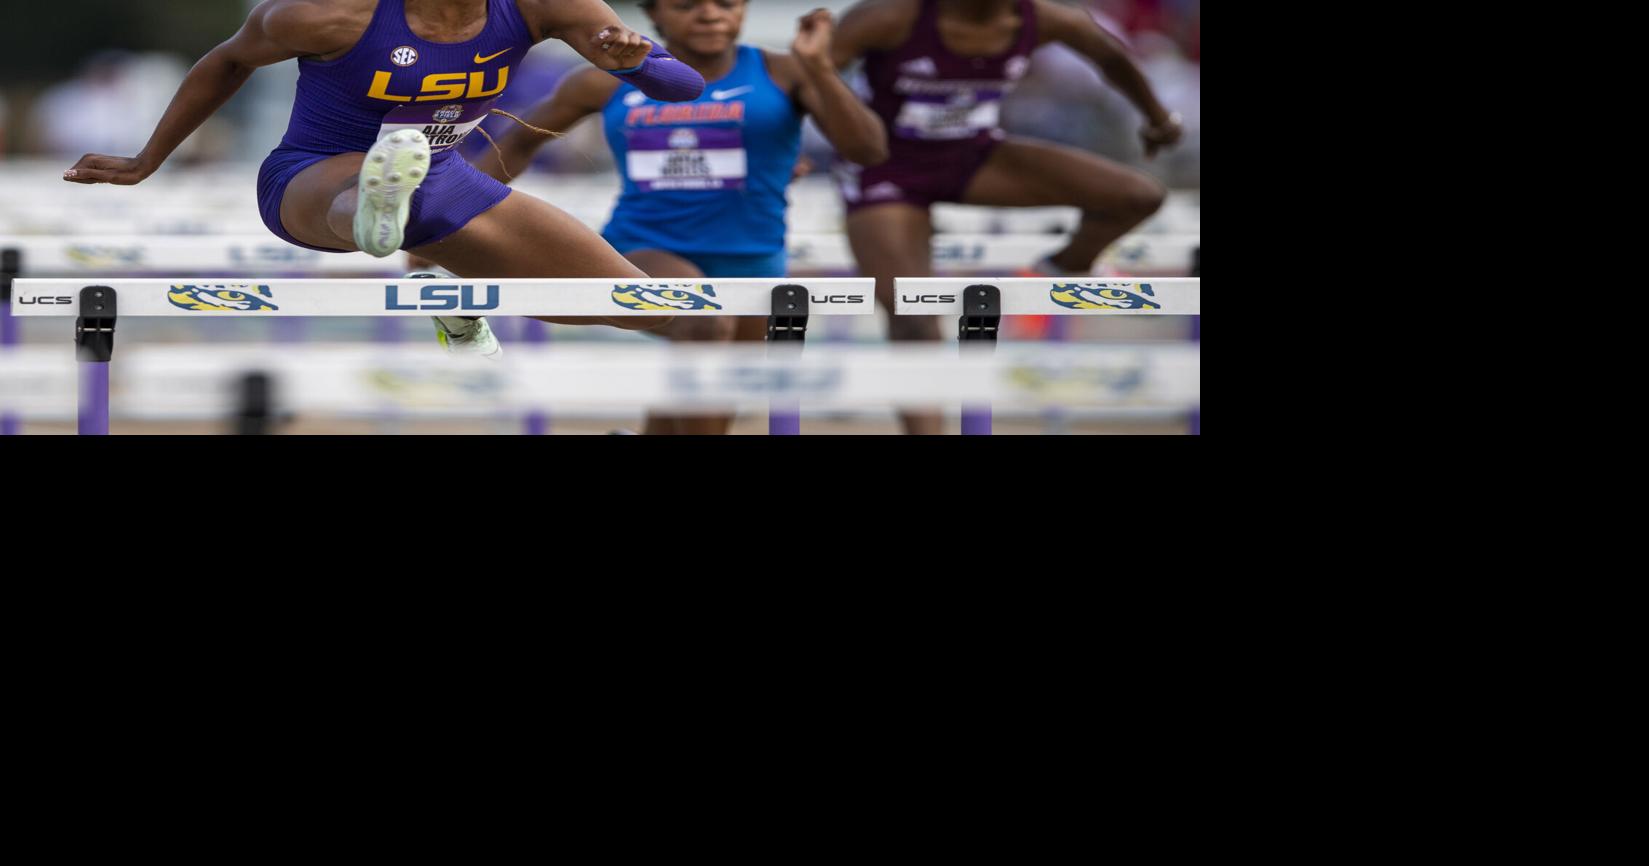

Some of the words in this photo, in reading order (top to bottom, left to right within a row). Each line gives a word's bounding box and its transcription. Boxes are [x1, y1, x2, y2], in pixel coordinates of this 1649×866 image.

[393, 48, 416, 65] SEC
[367, 66, 509, 102] LSU
[625, 101, 745, 126] FLORIDA
[18, 296, 72, 305] UCS
[385, 284, 500, 310] LSU
[811, 295, 864, 303] UCS
[902, 295, 956, 303] UCS
